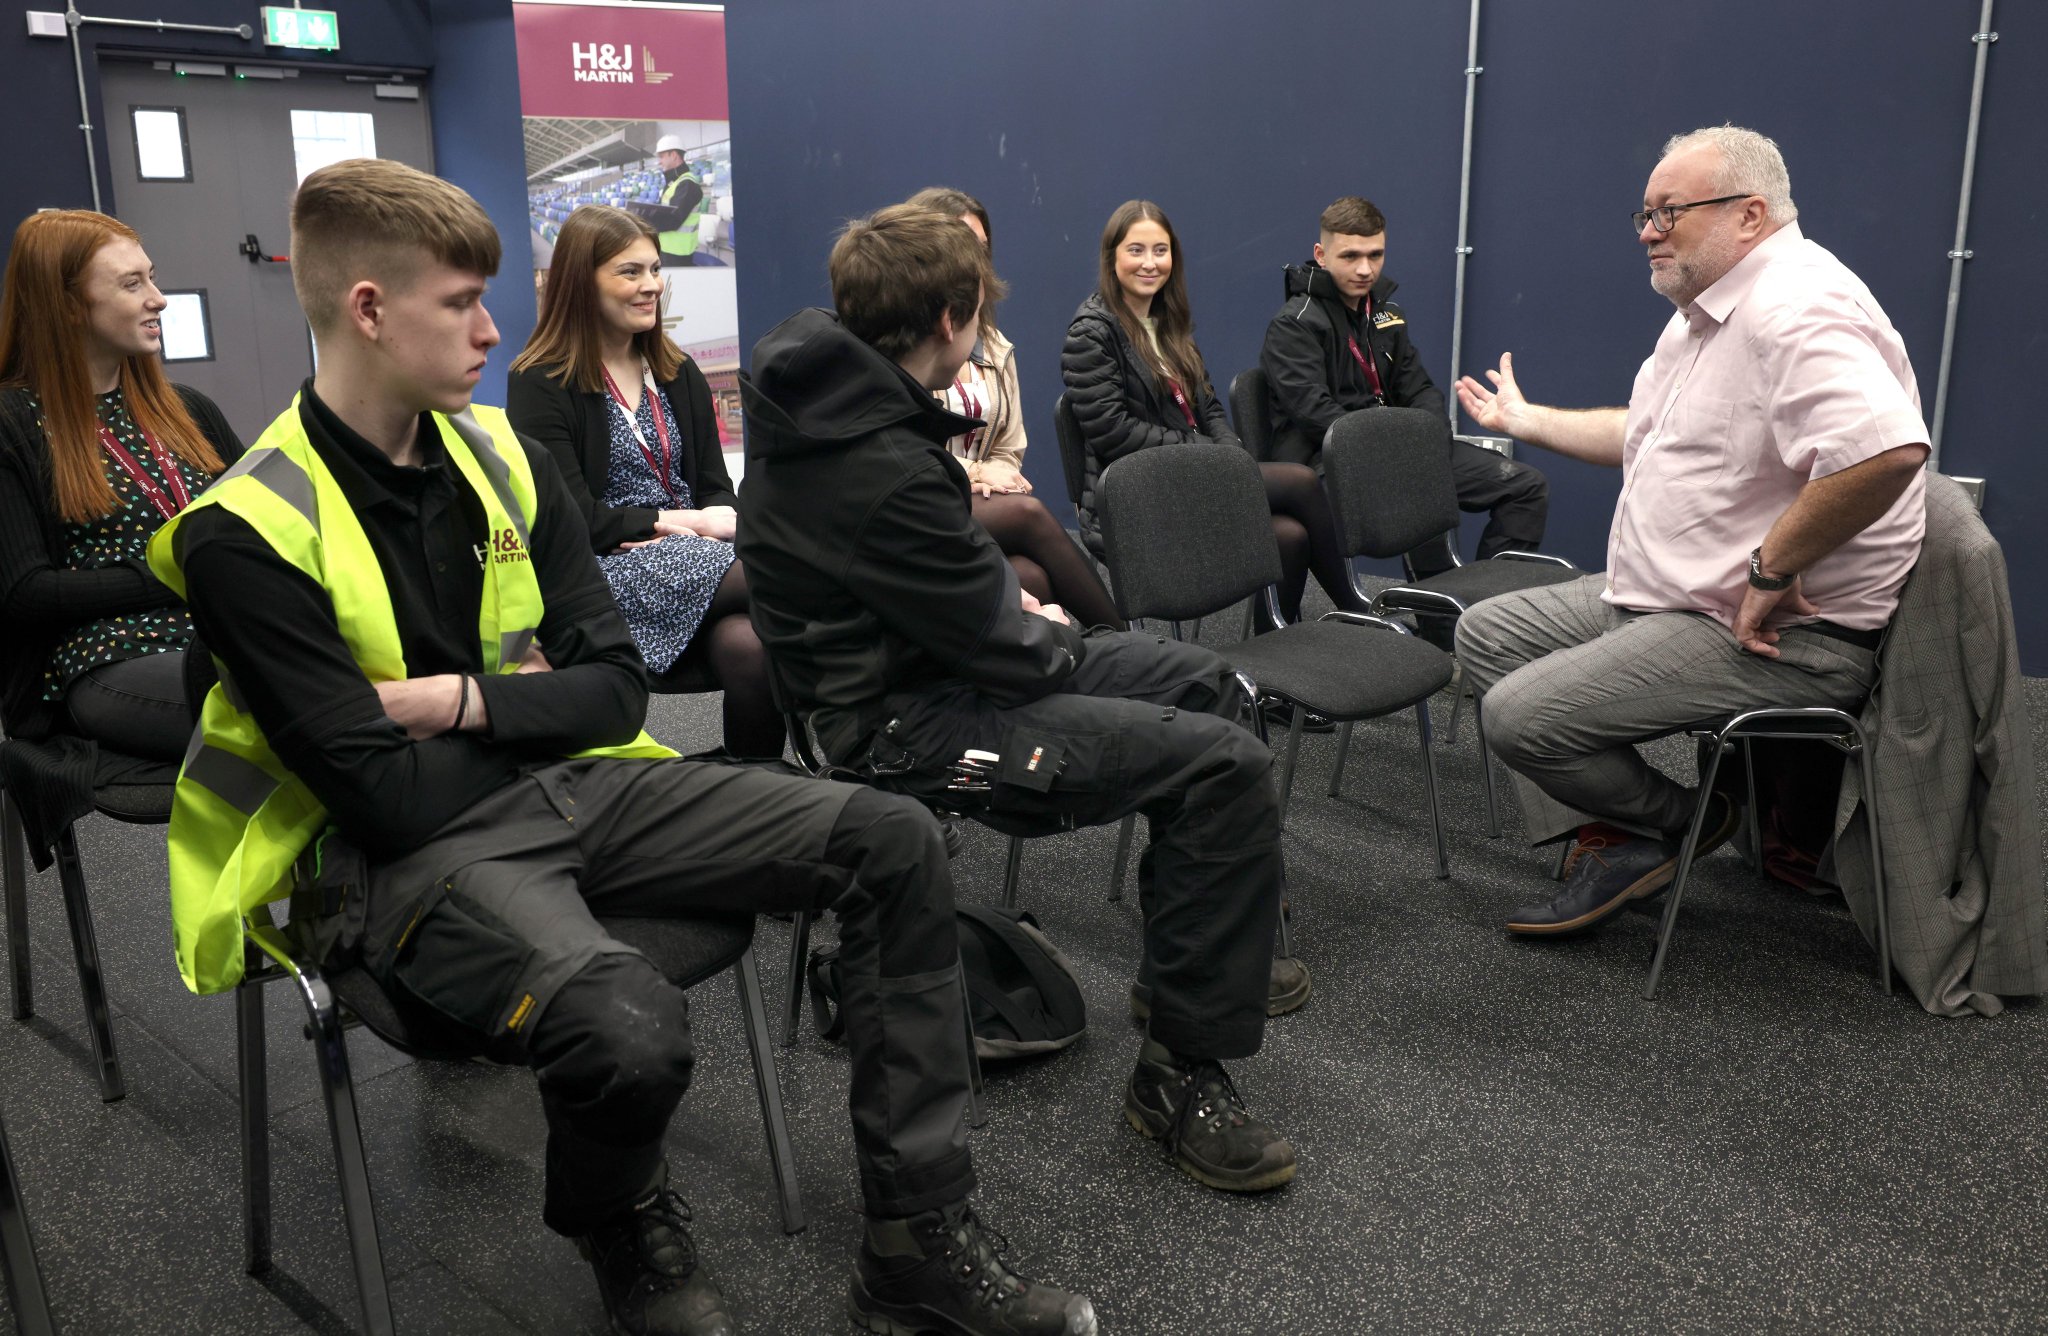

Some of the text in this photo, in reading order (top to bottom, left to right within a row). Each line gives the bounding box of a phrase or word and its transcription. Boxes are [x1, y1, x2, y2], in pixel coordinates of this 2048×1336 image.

[572, 42, 633, 71] H&J
[574, 70, 634, 84] MARTIN
[495, 551, 528, 564] ARTIN
